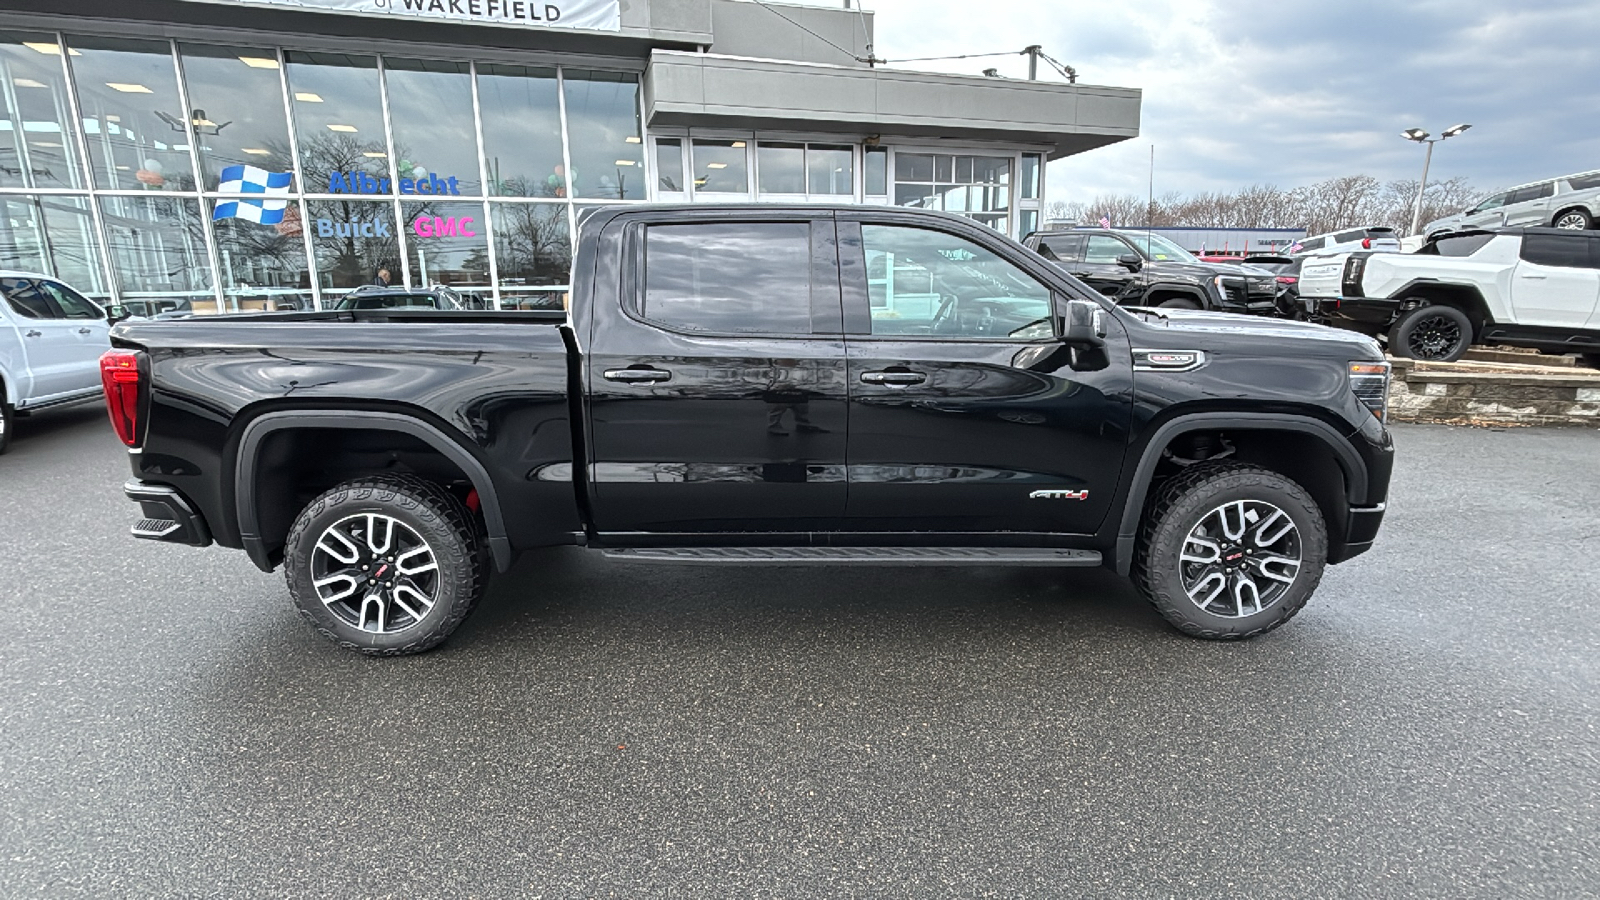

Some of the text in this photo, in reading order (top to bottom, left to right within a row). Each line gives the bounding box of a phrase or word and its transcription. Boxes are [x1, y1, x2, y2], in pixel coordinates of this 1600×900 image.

[403, 0, 561, 21] WAKEFIELD
[329, 171, 460, 196] Albrecht
[317, 216, 476, 238] Buick GMC
[1029, 489, 1089, 501] AT4
